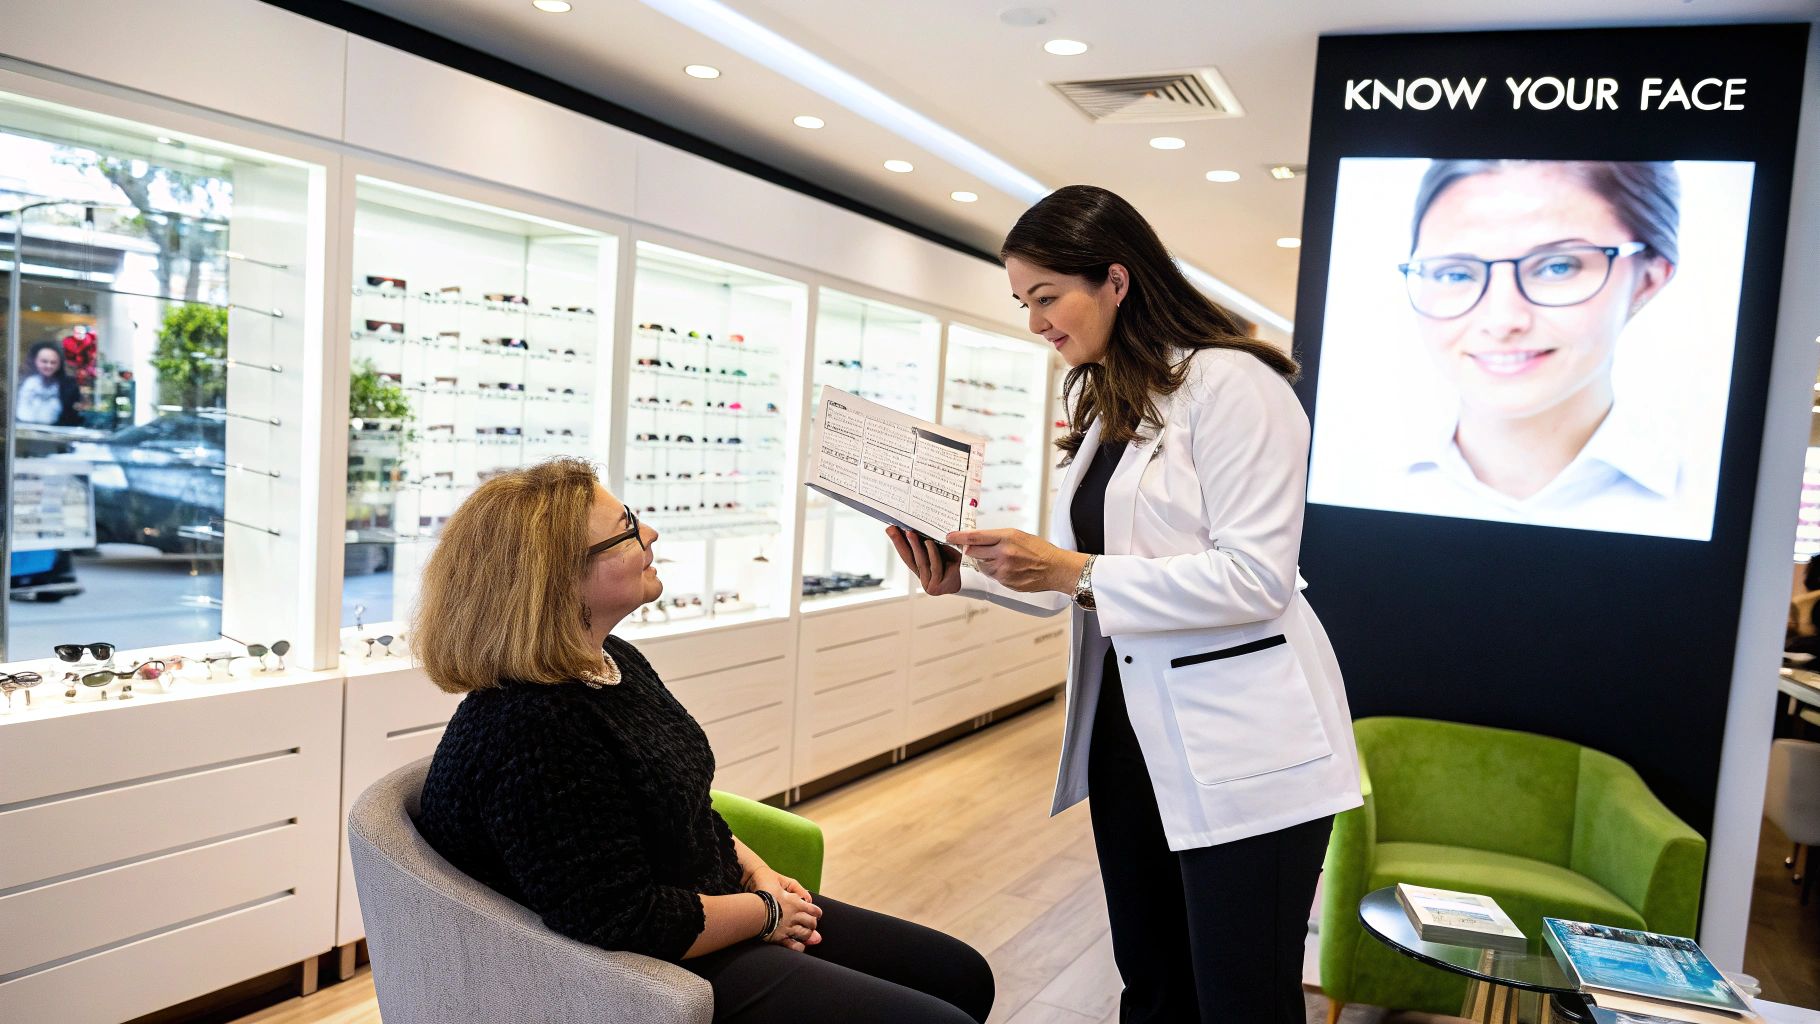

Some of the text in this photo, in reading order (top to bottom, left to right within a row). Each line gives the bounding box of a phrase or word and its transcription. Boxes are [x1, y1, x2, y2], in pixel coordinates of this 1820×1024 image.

[1344, 76, 1747, 111] KNOW YOUR FACE
